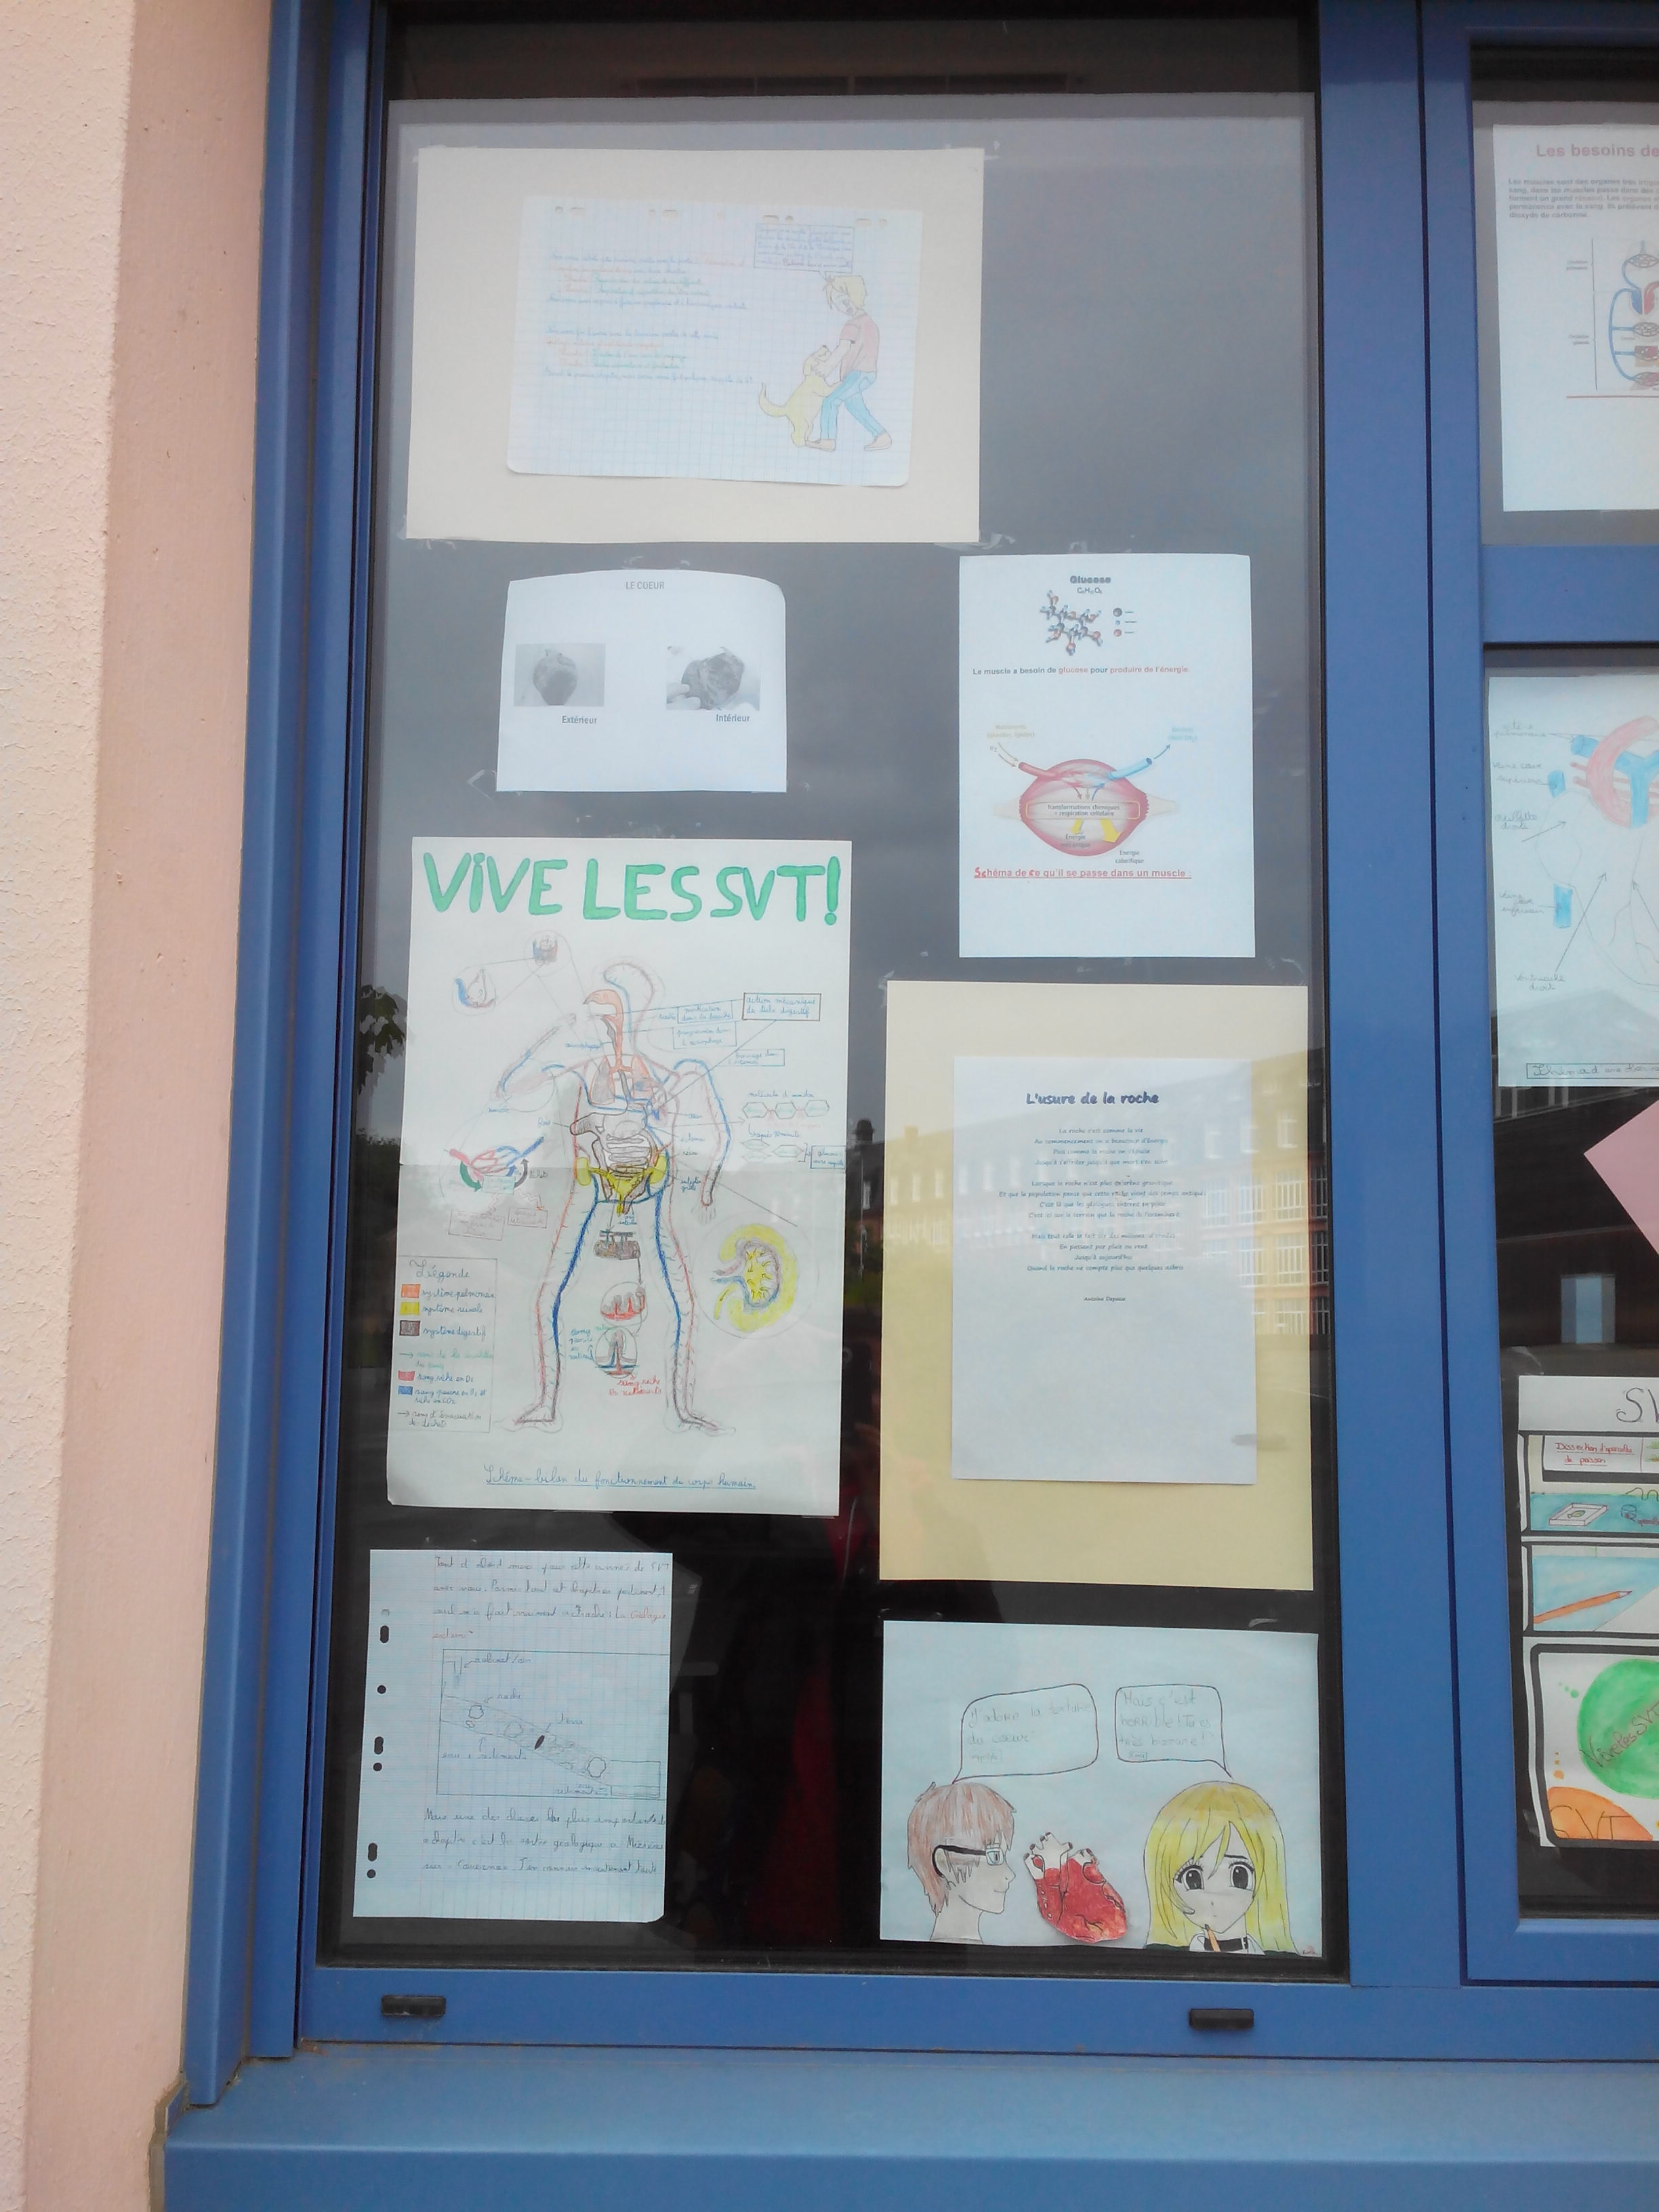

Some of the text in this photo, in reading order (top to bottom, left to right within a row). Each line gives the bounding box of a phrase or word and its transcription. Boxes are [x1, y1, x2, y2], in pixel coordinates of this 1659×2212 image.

[1536, 144, 1565, 157] Les
[1571, 144, 1635, 157] besoins
[1070, 575, 1111, 583] Glucose
[626, 581, 665, 590] LE COEUR
[1059, 667, 1088, 675] glucose
[1109, 666, 1142, 674] produire
[562, 715, 597, 724] Extérieur
[716, 714, 750, 723] Intérieur
[975, 867, 1012, 878] Schéma
[1015, 869, 1027, 877] de
[1029, 869, 1040, 877] ce
[1043, 868, 1063, 878] qu'il
[1080, 870, 1107, 879] passe
[1111, 869, 1134, 877] dans
[582, 857, 702, 922] LES
[710, 855, 841, 926] SVT!
[1025, 1091, 1160, 1105] L'usure de la roche
[422, 1324, 456, 1340] système
[1564, 1454, 1573, 1463] de
[574, 1469, 589, 1483] du
[595, 1471, 668, 1490] fonctionnement
[687, 1477, 712, 1490] corps
[1030, 1706, 1041, 1718] la
[967, 1732, 983, 1745] du
